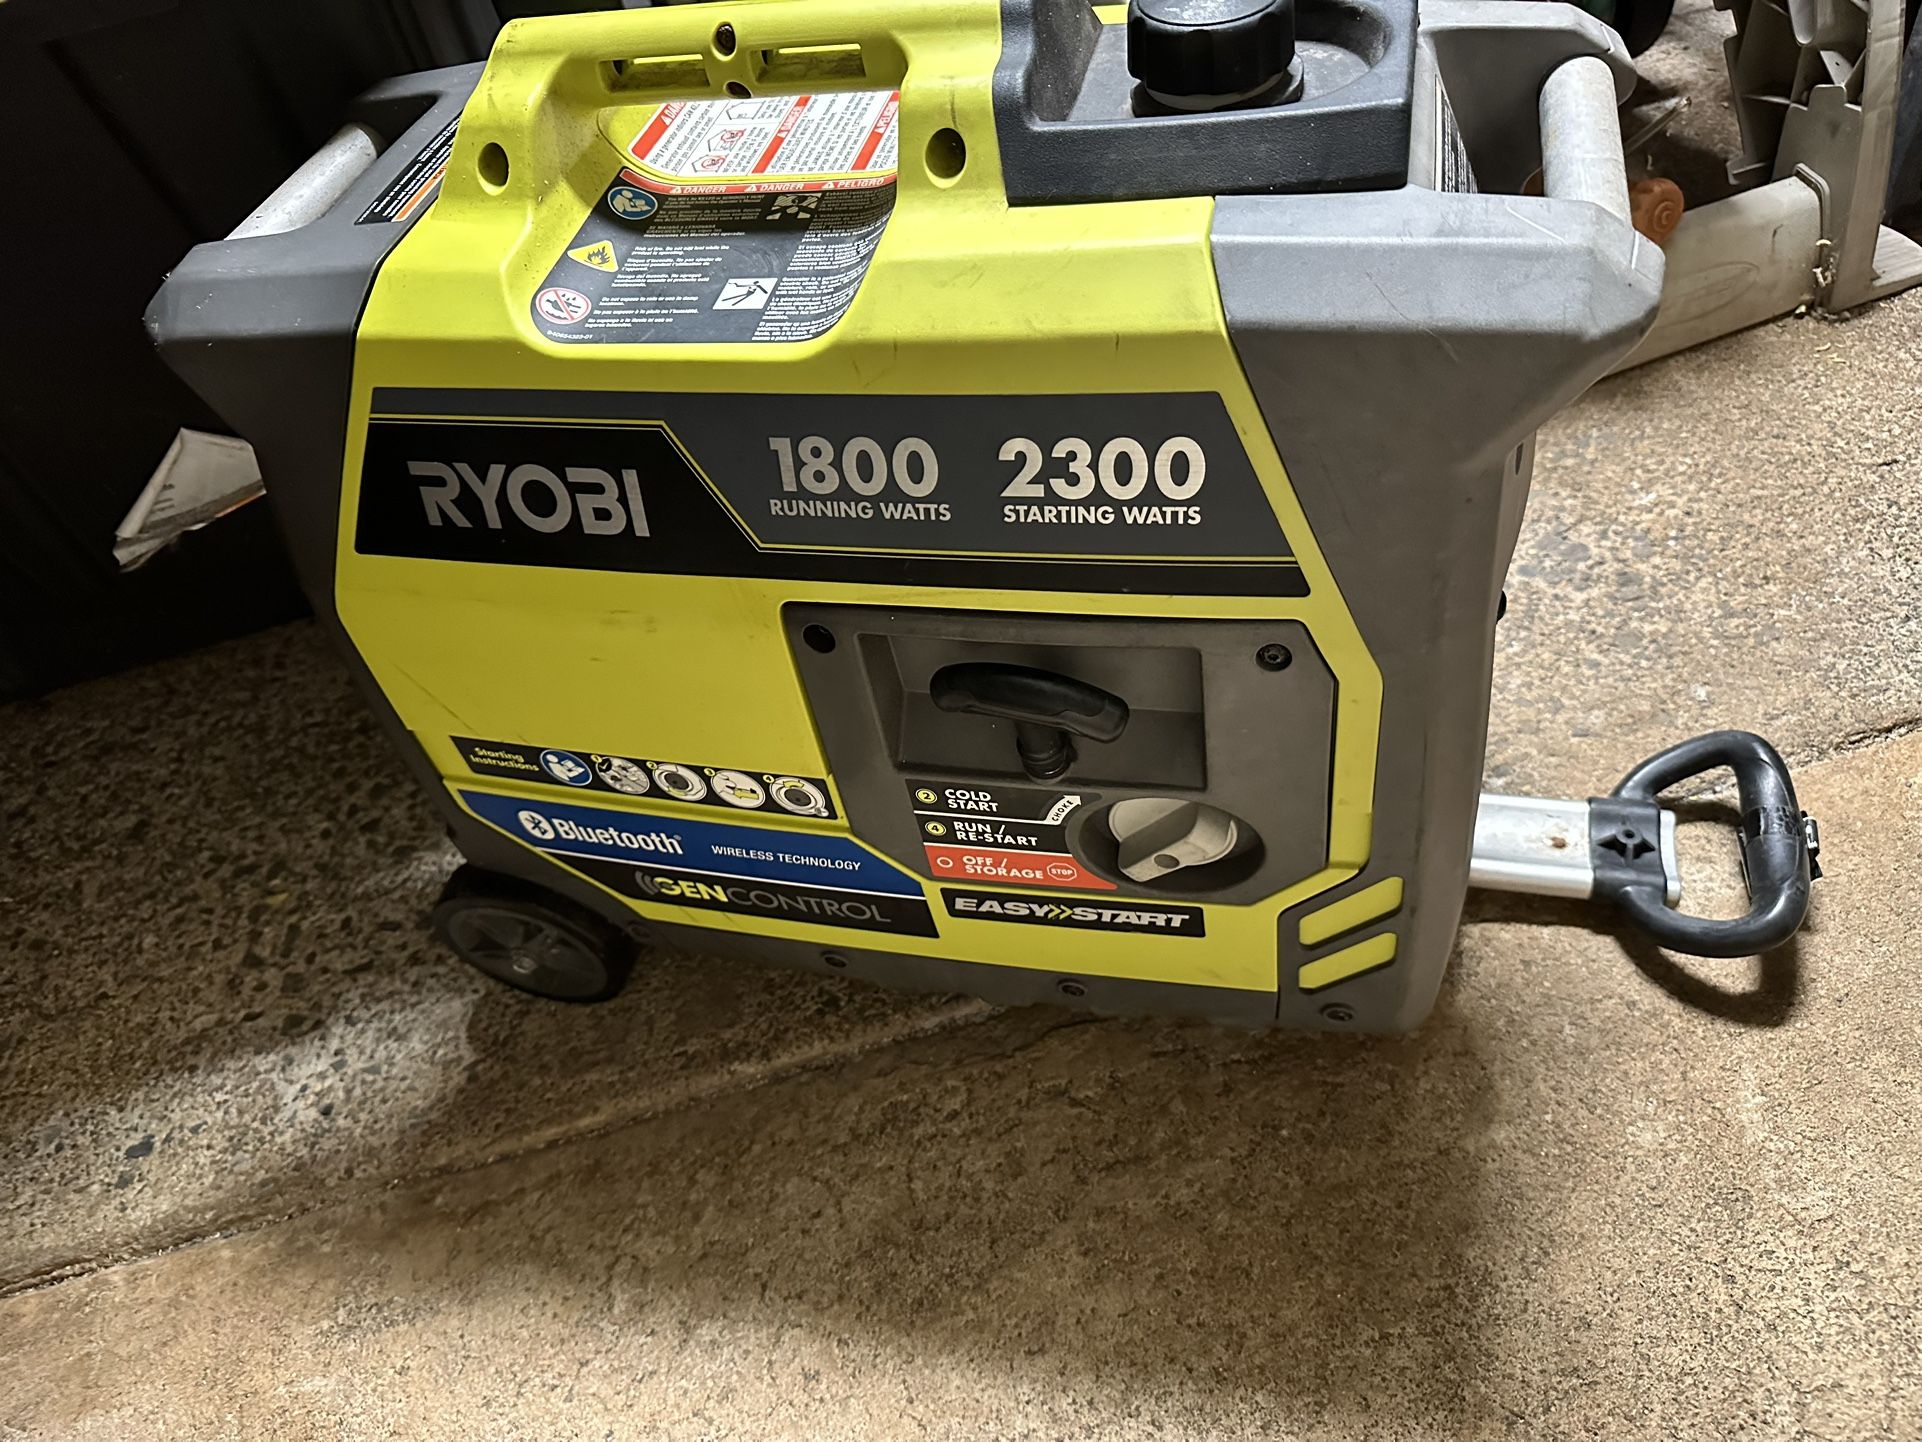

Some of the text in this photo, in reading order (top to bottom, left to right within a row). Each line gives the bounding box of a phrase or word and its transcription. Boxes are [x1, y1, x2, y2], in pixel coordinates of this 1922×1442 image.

[684, 186, 727, 194] DANGER
[760, 182, 804, 192] DANGER
[837, 178, 884, 189] PELIGRO
[769, 436, 938, 497] 1800
[998, 436, 1206, 500] 2300
[407, 461, 650, 537] RYOBI
[769, 499, 951, 521] RUNNING WATTS
[1003, 504, 1201, 524] STARTING WATTS
[470, 754, 540, 772] Instructions
[474, 747, 525, 762] Starting
[944, 788, 992, 801] COLD
[947, 798, 998, 812] START
[1051, 799, 1074, 822] CHOKE
[953, 821, 992, 833] RUN
[551, 818, 683, 854] Bluetooth
[955, 831, 1038, 847] RE-START
[711, 844, 861, 871] WIRELESS TECHNOLOGY
[963, 855, 993, 867] OFF
[965, 865, 1044, 880] STORAGE
[1051, 868, 1073, 876] STOP
[652, 876, 891, 923] GENCONTROL
[954, 897, 1190, 928] EASY START
